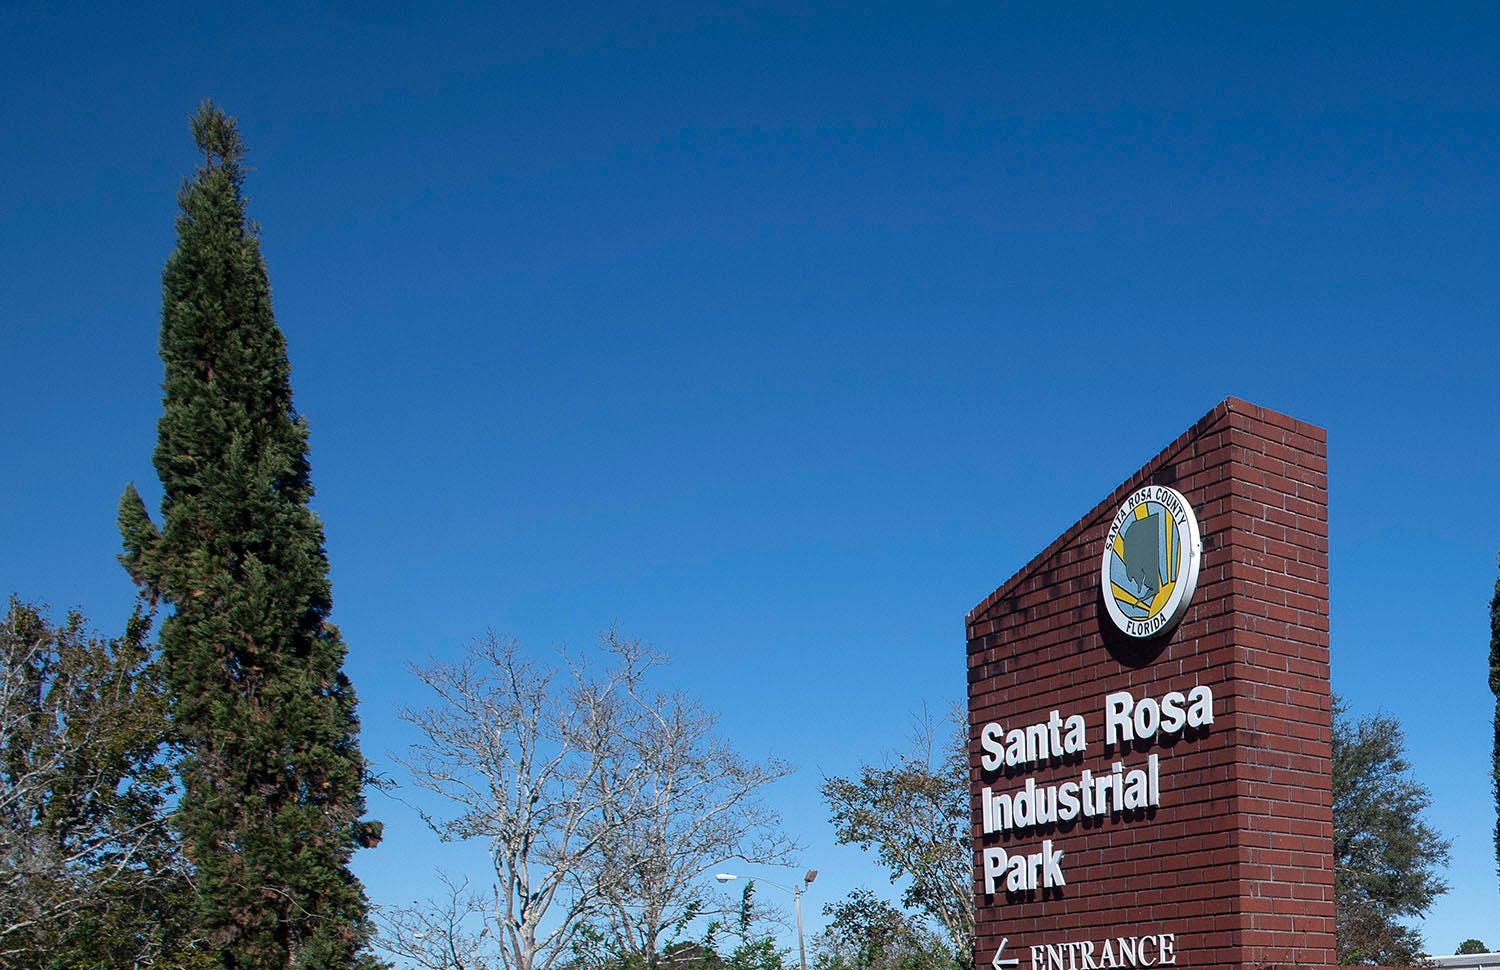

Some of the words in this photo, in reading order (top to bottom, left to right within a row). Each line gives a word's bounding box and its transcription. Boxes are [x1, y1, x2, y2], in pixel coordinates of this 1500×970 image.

[1106, 510, 1127, 551] SANTA
[1128, 487, 1152, 510] ROSA
[1155, 487, 1187, 526] COUNTY
[1126, 612, 1167, 636] FLORIDA
[981, 710, 1087, 772] Santa
[1105, 685, 1214, 745] Rosa
[982, 753, 1160, 834] Industrial
[983, 839, 1066, 895] Park
